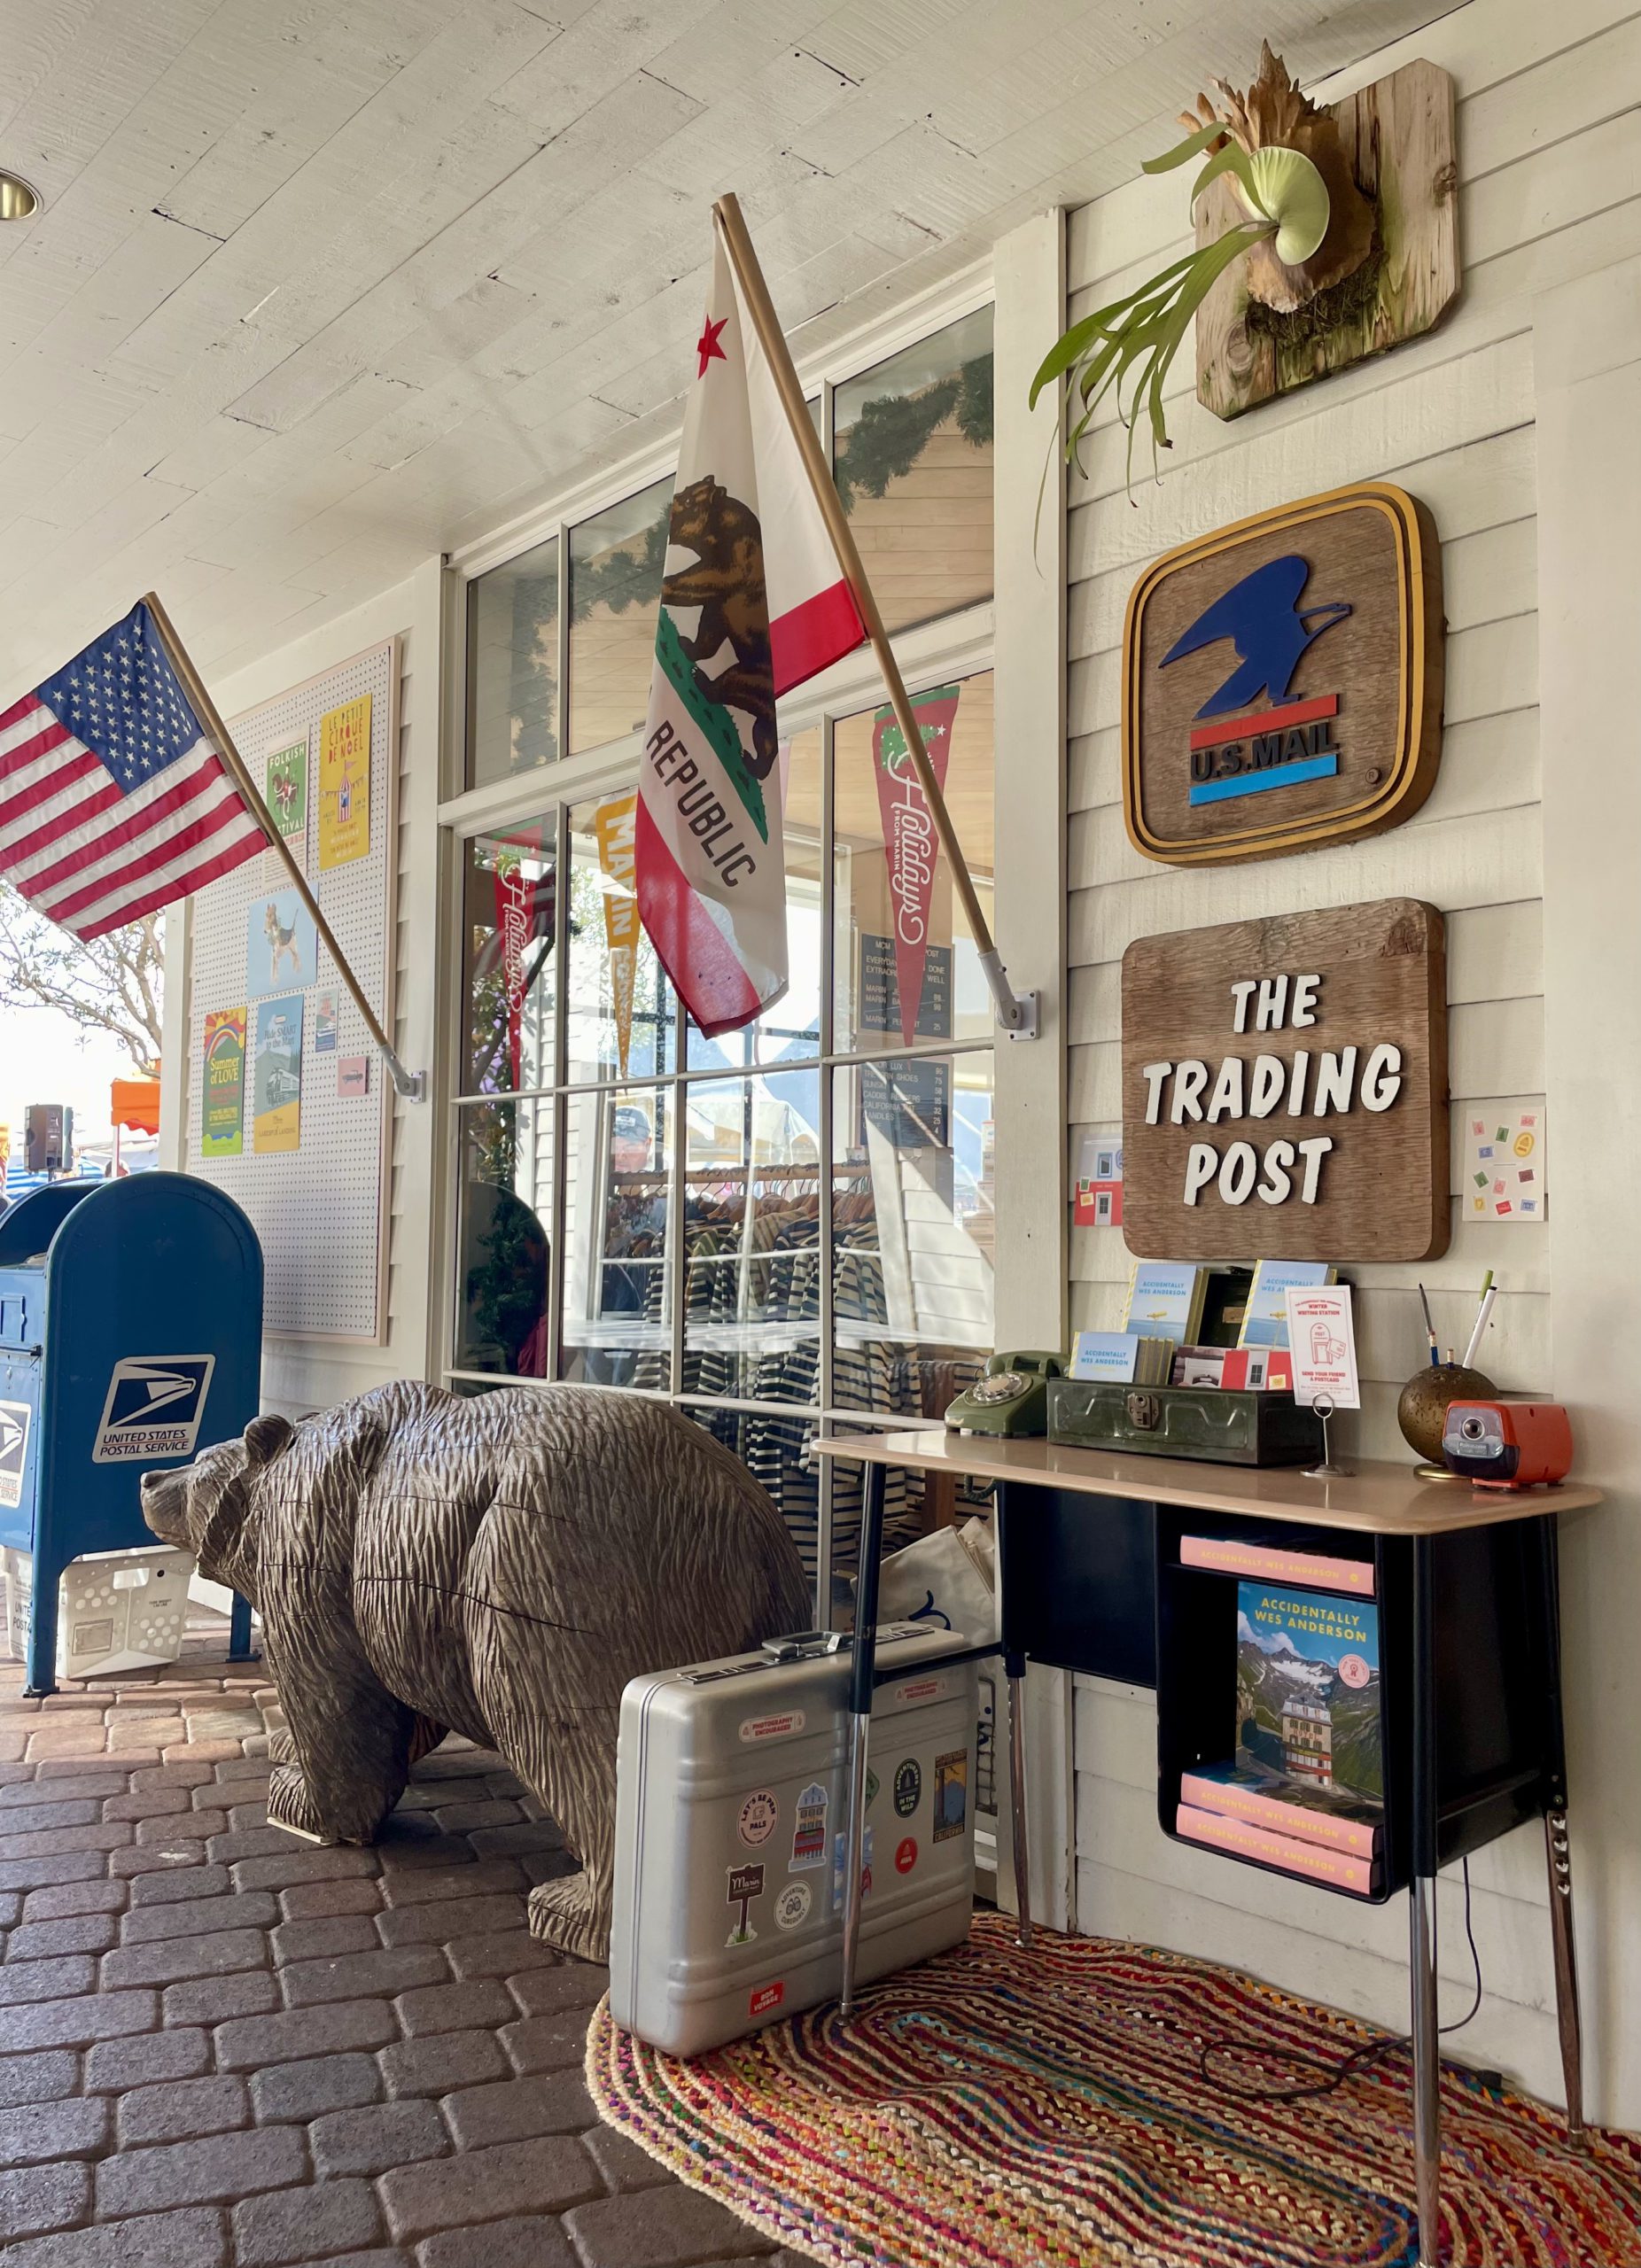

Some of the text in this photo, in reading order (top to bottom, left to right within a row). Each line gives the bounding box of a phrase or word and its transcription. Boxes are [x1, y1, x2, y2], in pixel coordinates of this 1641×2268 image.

[329, 703, 363, 731] LE PETIT
[329, 717, 362, 746] CIRQUE
[269, 744, 305, 770] FOLKISH
[646, 719, 757, 888] REPUBLIC
[277, 819, 305, 836] STIVAL
[887, 750, 931, 945] Holidays
[928, 965, 945, 975] DONE
[927, 975, 945, 984] WELL
[1231, 974, 1320, 1033] THE
[866, 1014, 886, 1024] MARIN
[210, 1057, 239, 1071] Summer
[210, 1068, 238, 1084] of LOVE
[897, 1073, 919, 1083] SHOES
[1143, 1044, 1401, 1125] TRADING
[1183, 1137, 1333, 1206] POST
[103, 1429, 187, 1444] UNITED STATES
[100, 1441, 189, 1456] POSTAL SERVICE
[1201, 1551, 1340, 1580] ACCIDENTALLY WES ANDERSON
[1261, 1597, 1360, 1627] ACCIDENTALLY
[1255, 1609, 1367, 1643] WES ANDERSON
[752, 1716, 793, 1730] PHOTOGRAPHY
[755, 1724, 791, 1736] ENCOURAGED
[741, 1797, 756, 1821] LET'S
[766, 1798, 776, 1815] PEN
[1201, 1791, 1339, 1839] ACCIDENTALLY WES ANDERSON
[750, 1820, 766, 1830] PALS
[1197, 1822, 1336, 1874] ACCIDENTALLY WES ANDERSON
[731, 1876, 760, 1891] Marin
[781, 1886, 806, 1904] ADVENTURE
[754, 1994, 779, 2012] VOYAGE
[761, 1988, 774, 2002] BON
